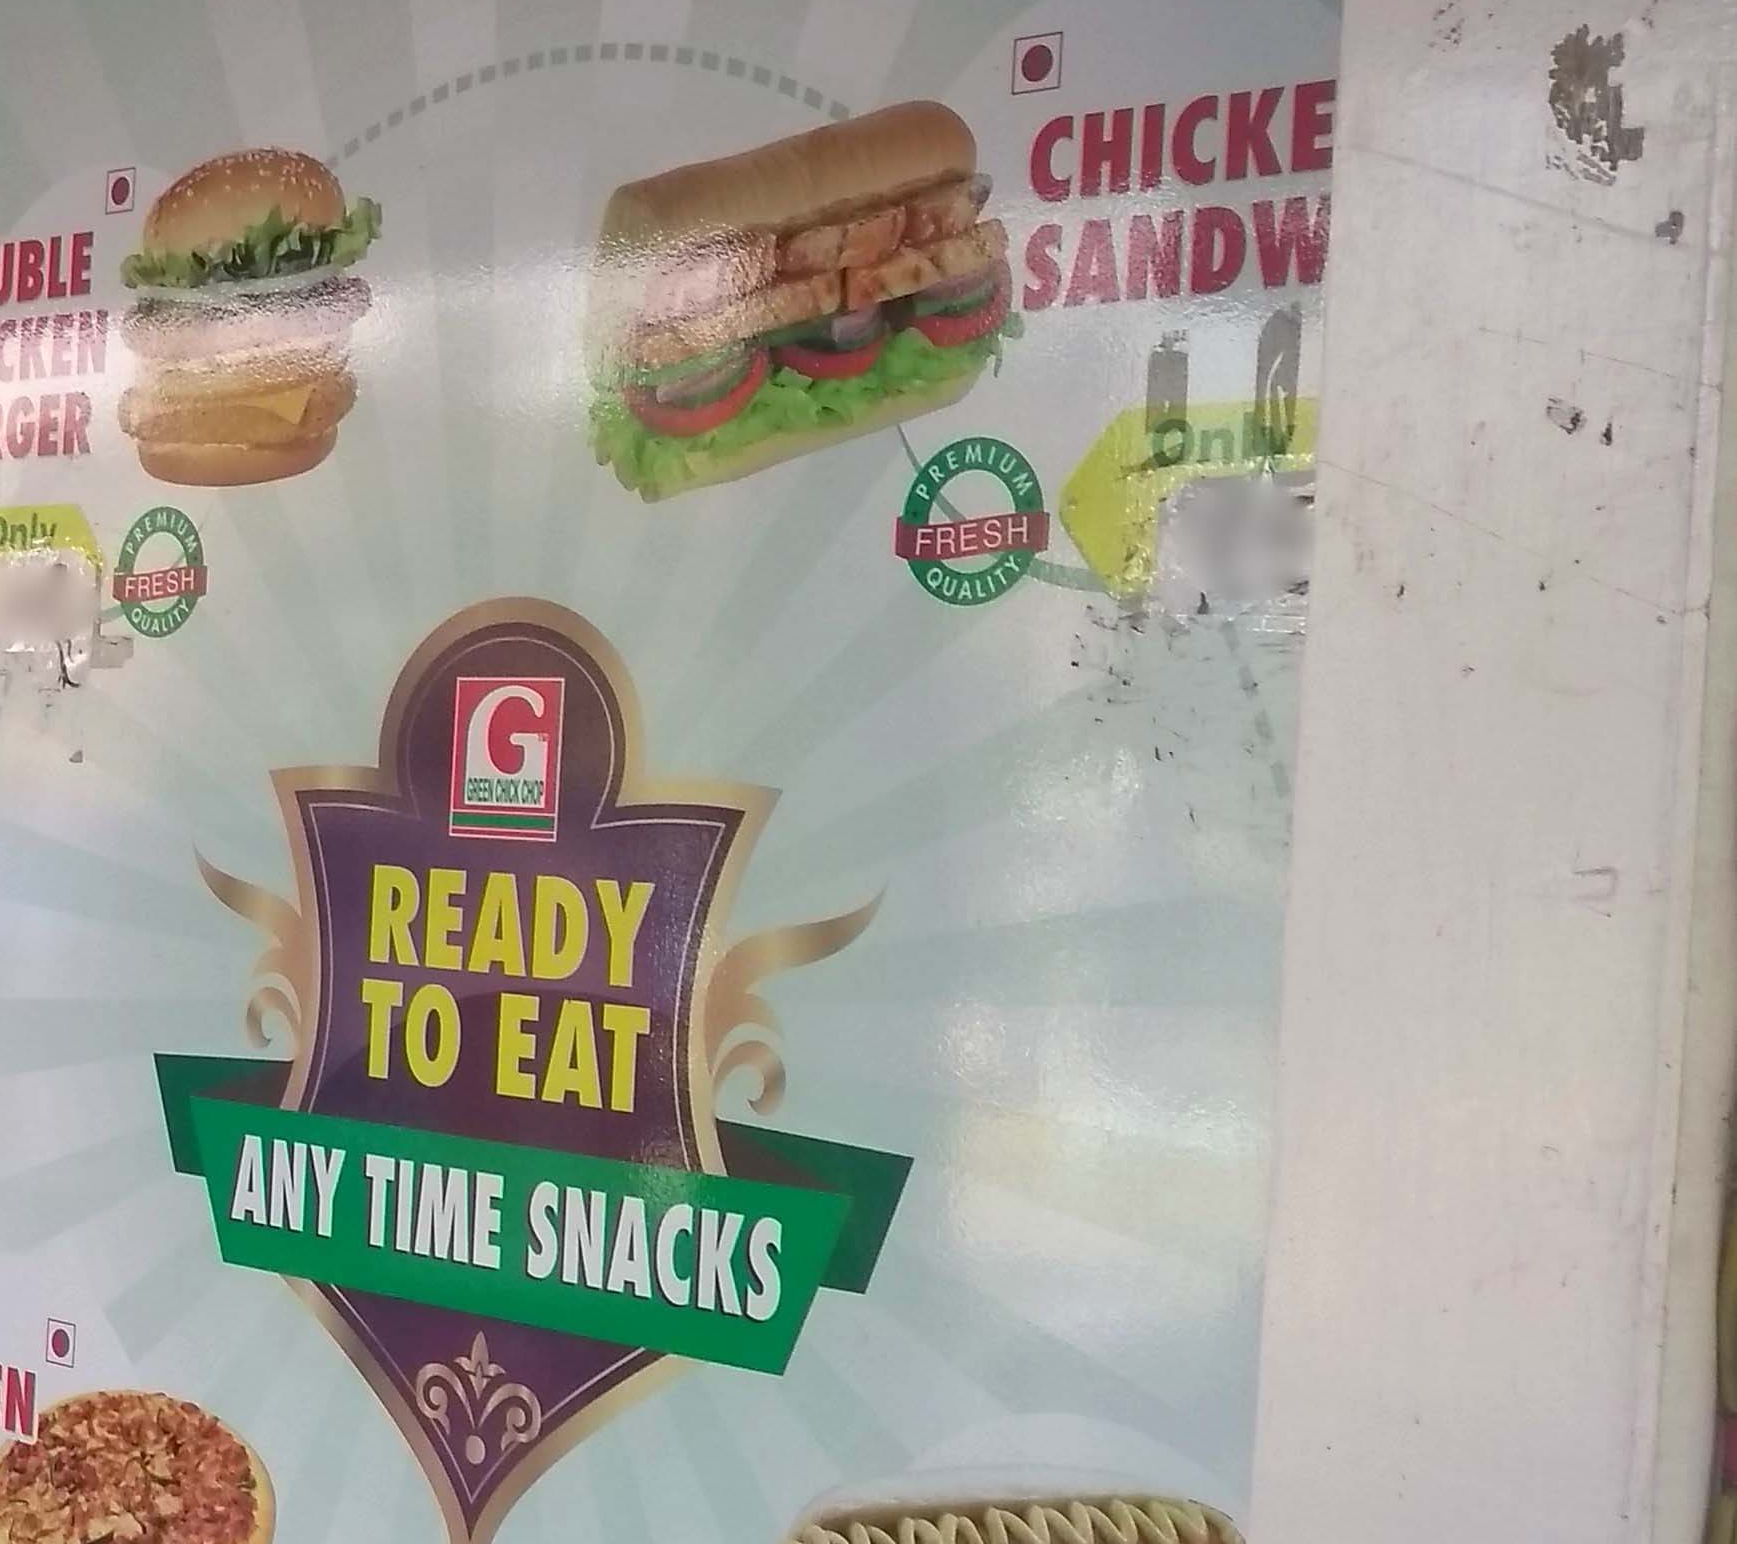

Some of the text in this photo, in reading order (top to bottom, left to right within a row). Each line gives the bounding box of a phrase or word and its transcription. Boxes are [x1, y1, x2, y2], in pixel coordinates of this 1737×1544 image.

[1029, 78, 1338, 203] CHICKE
[1021, 194, 1333, 313] SANDW
[915, 443, 1034, 501] PREMIUM
[126, 512, 199, 555] PREMIUM
[915, 516, 1029, 556] FRESH
[125, 568, 195, 599] FRESH
[926, 555, 1021, 601] QUALITY
[131, 597, 190, 634] QUALITY
[466, 777, 494, 802] GREEN
[495, 778, 520, 805] CHICK
[368, 862, 656, 987] READY
[362, 978, 653, 1114] TO EAT
[230, 1133, 786, 1325] ANY TIME SNACKS
